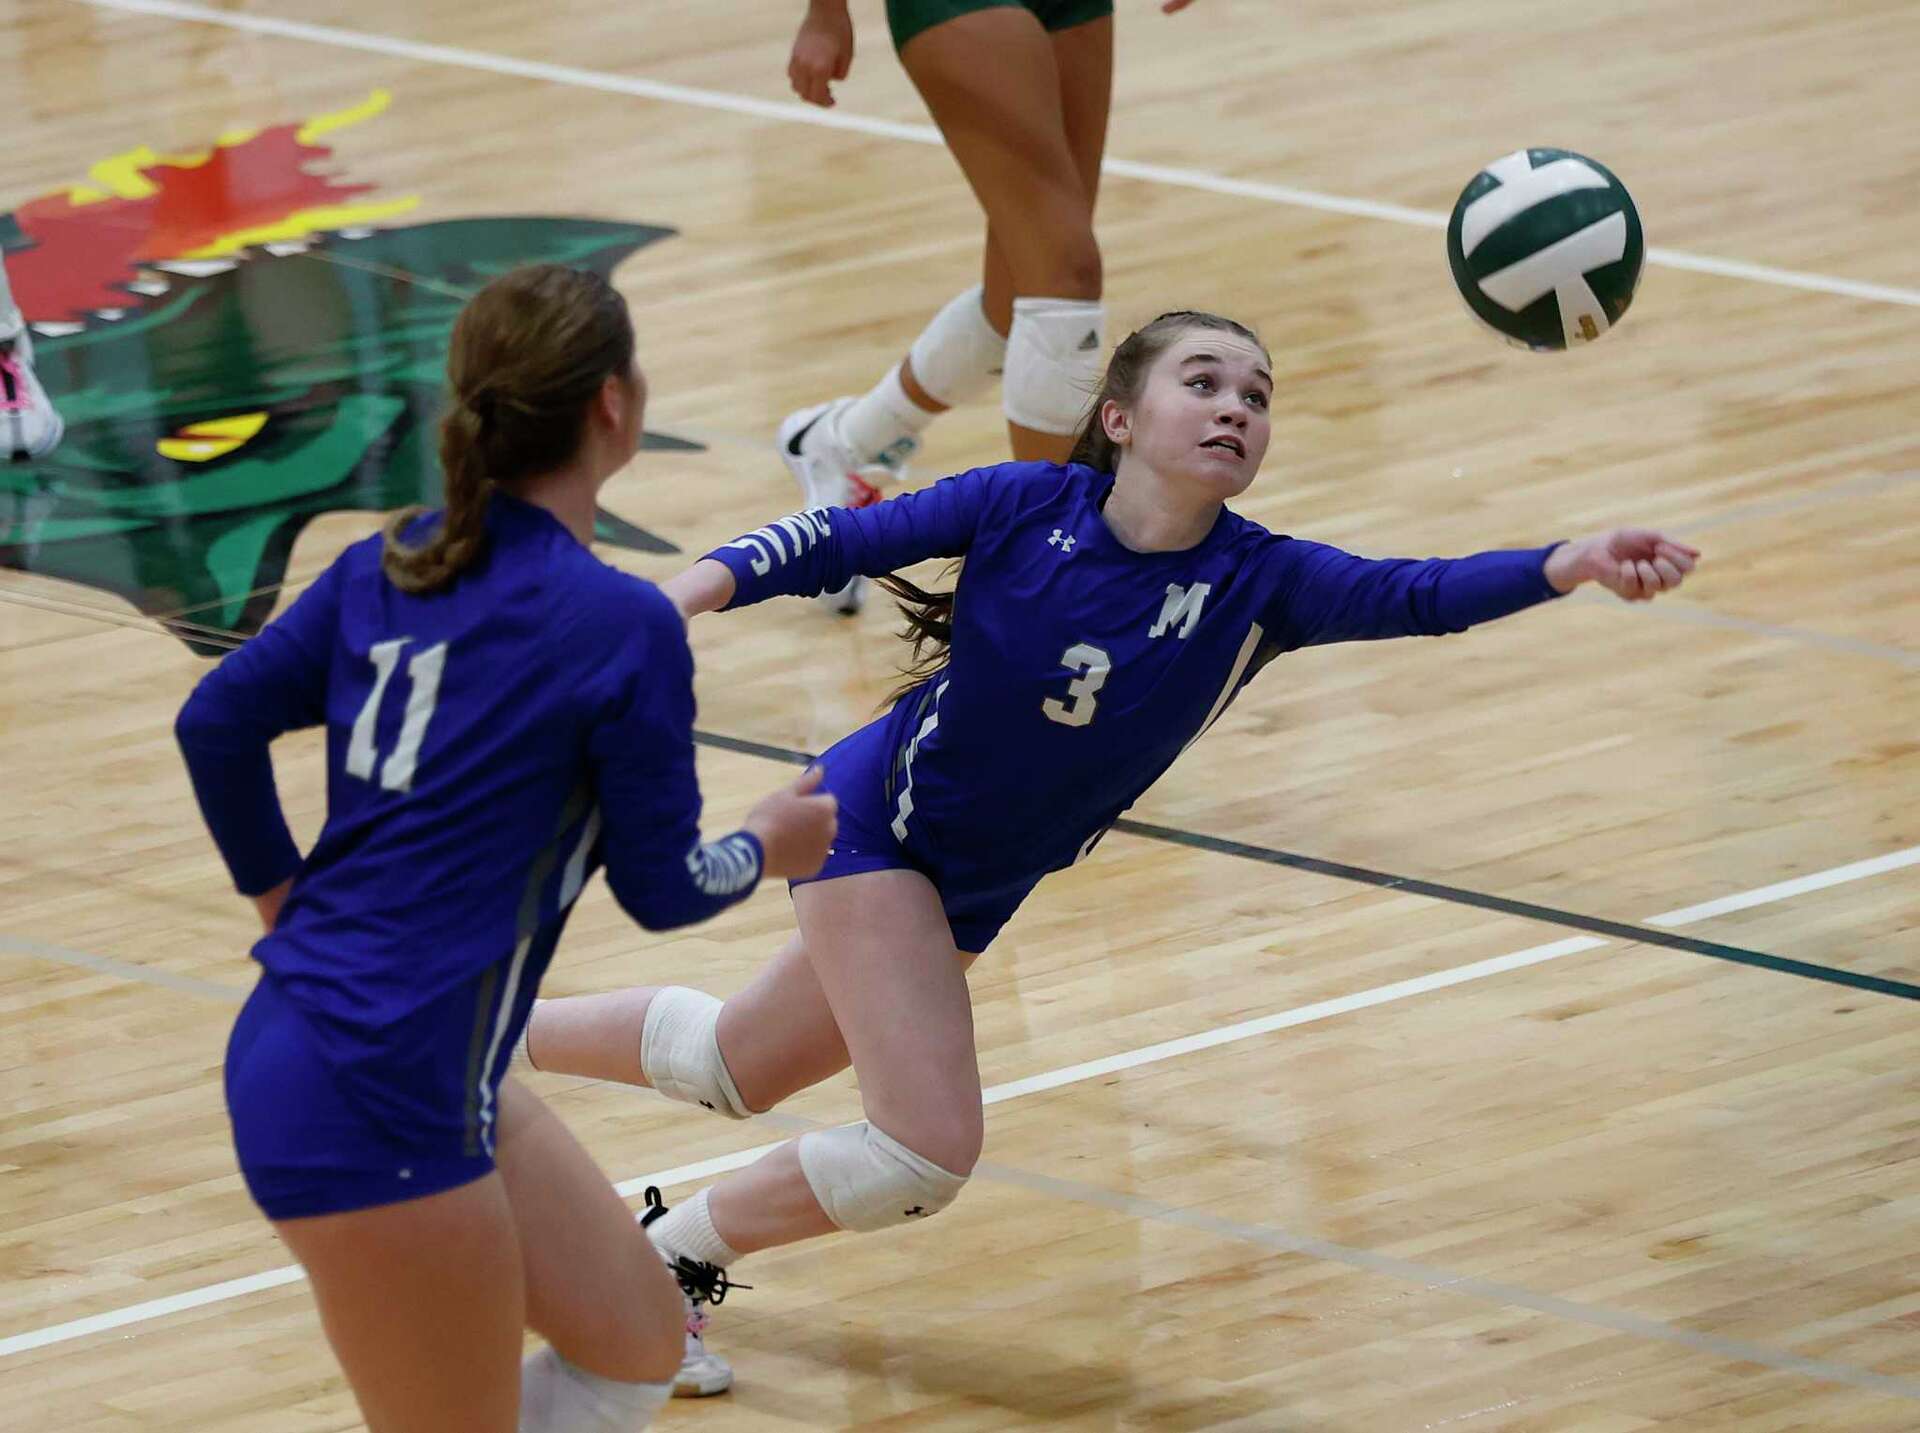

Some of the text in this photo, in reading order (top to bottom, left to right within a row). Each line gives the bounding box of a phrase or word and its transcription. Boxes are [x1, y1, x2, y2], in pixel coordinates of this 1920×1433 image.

[1148, 582, 1211, 639] M
[345, 635, 448, 794] 11
[1042, 643, 1111, 727] 3
